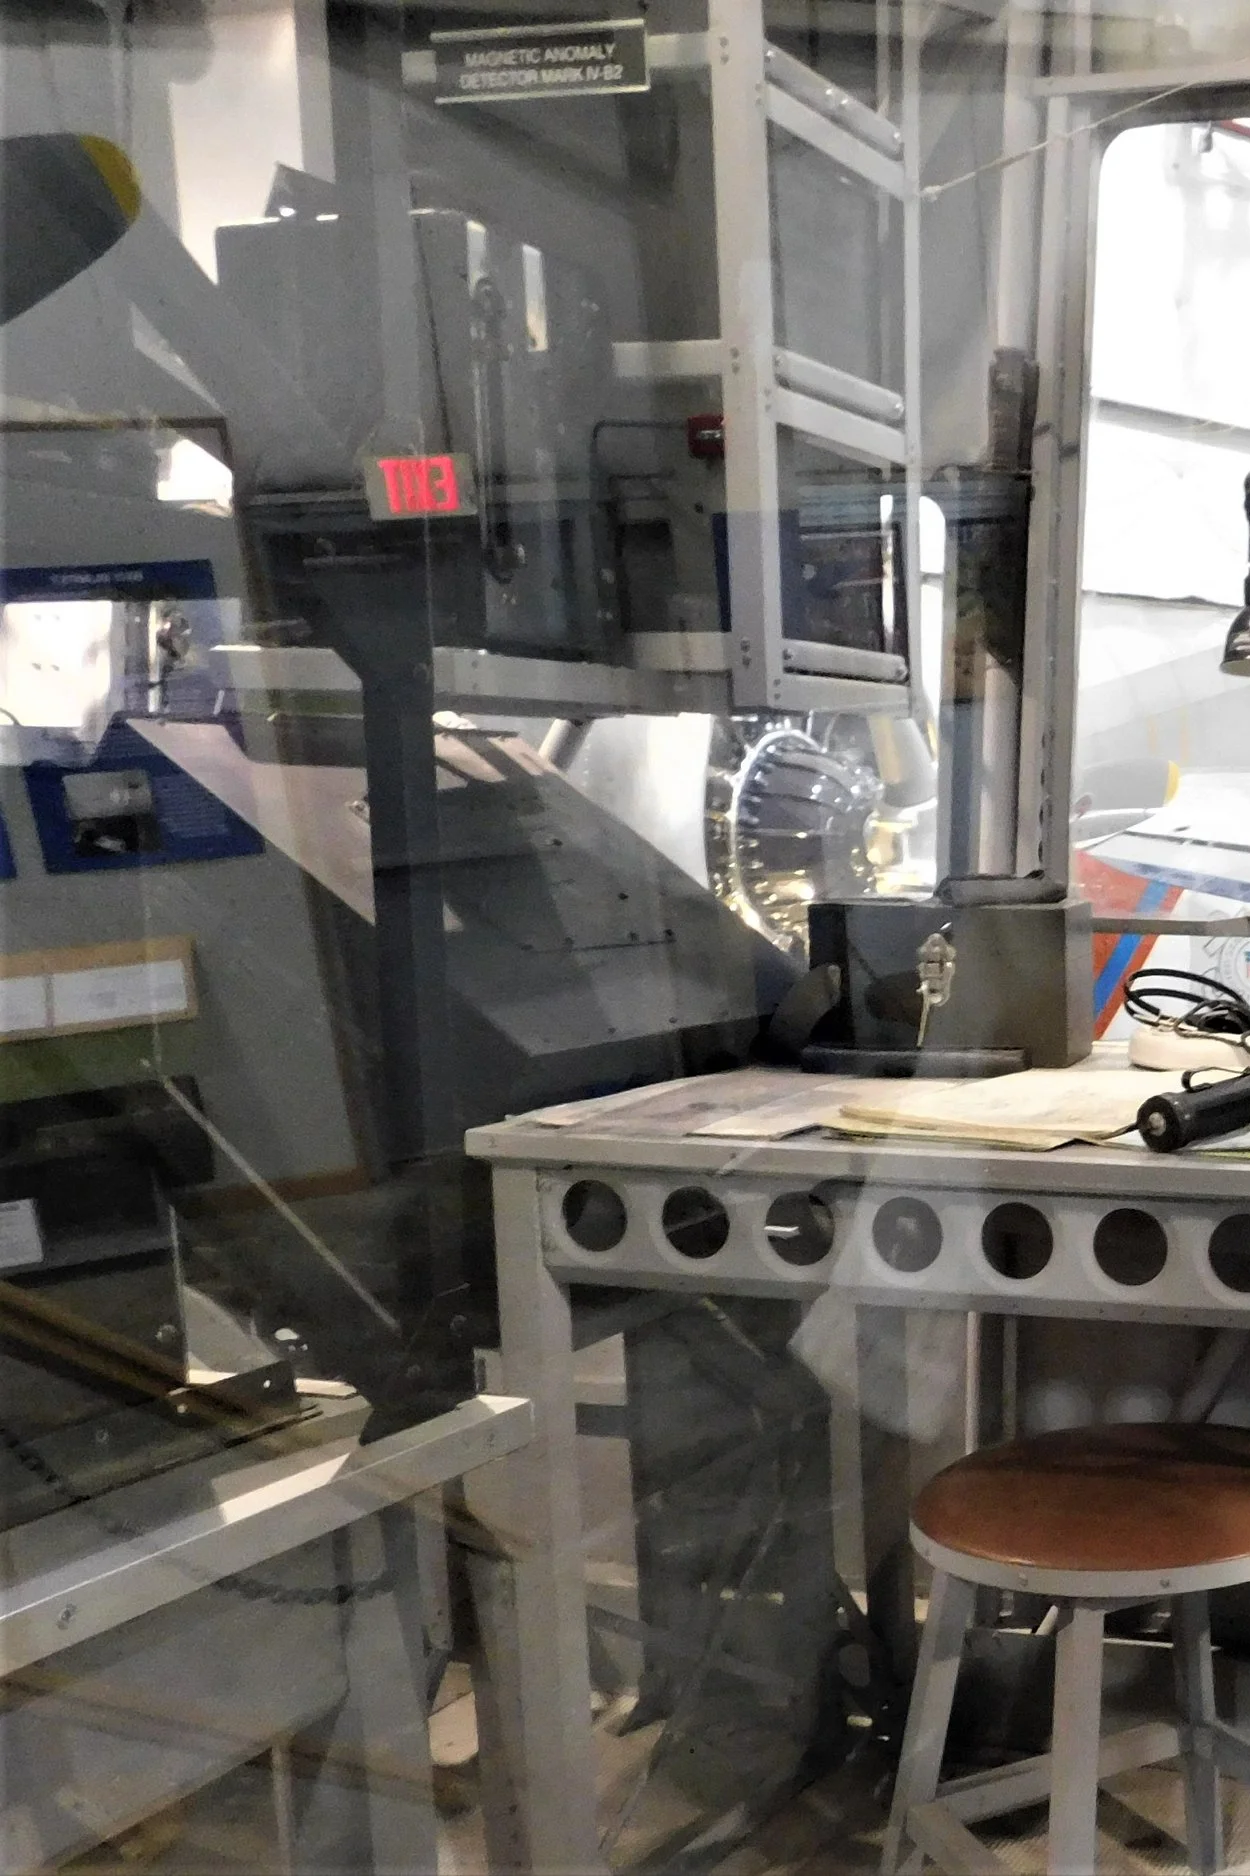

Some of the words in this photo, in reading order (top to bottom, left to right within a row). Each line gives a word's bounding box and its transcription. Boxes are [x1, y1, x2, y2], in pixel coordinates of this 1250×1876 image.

[464, 48, 540, 67] MAGNETIC
[544, 43, 616, 63] ANOMALY
[459, 69, 538, 89] DETECTOR
[541, 66, 584, 83] MARK
